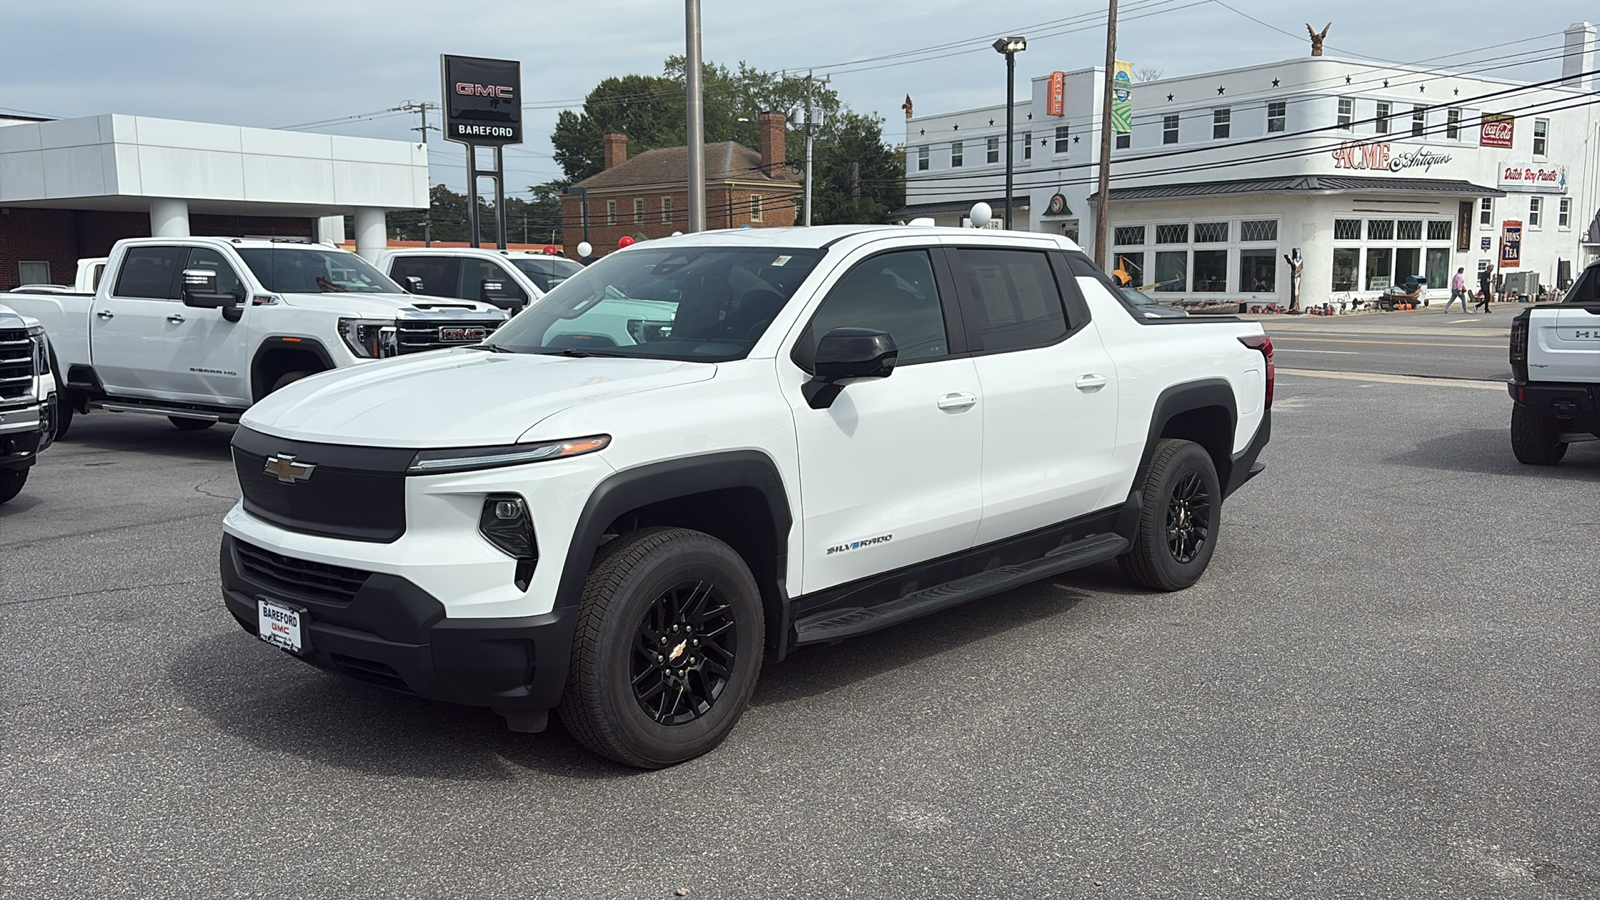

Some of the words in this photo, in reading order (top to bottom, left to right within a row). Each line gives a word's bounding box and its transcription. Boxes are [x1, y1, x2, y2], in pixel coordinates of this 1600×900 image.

[456, 82, 513, 98] GMC
[458, 125, 513, 137] BAREFORD
[1332, 140, 1390, 170] ACME
[1389, 145, 1453, 173] Antiques
[1504, 167, 1522, 181] Dutch
[1524, 168, 1537, 184] Boy
[1536, 168, 1557, 182] Paints
[1504, 246, 1518, 259] TEA
[443, 328, 484, 340] GMC
[826, 534, 893, 555] SILVERADO
[263, 607, 297, 627] BAREFORD
[271, 622, 290, 635] GMC
